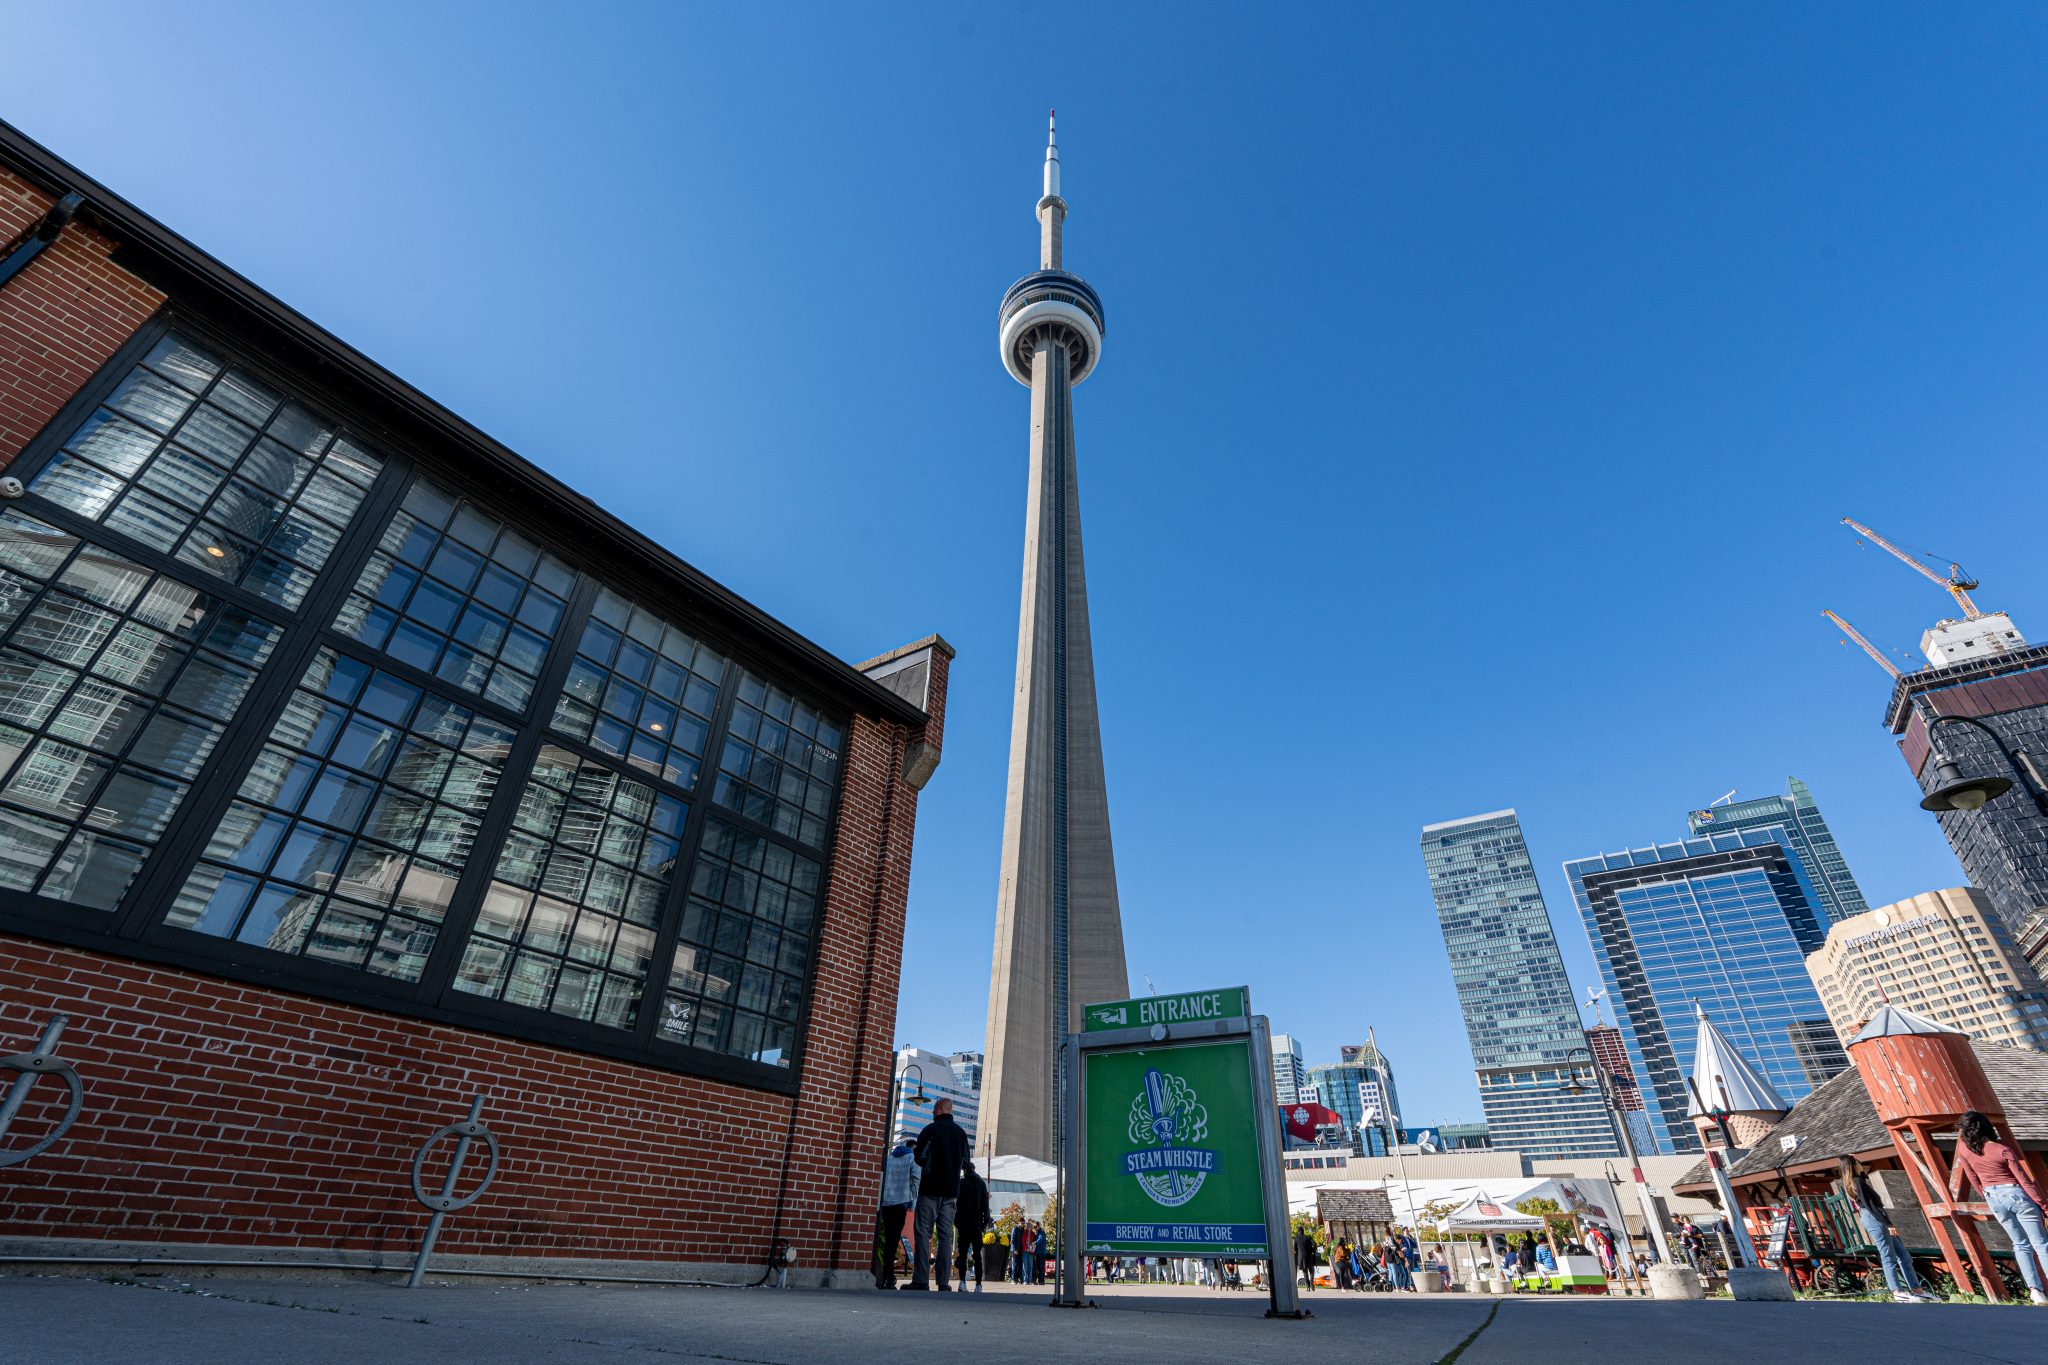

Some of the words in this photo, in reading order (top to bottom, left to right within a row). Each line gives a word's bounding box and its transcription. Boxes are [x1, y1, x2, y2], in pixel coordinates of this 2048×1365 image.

[1140, 994, 1221, 1024] ENTRANCE
[666, 1018, 689, 1030] SMILE
[1127, 1150, 1162, 1171] STEAM
[1163, 1150, 1213, 1169] WHISTLE
[1116, 1225, 1154, 1240] BREWERY
[1158, 1228, 1170, 1238] AND
[1172, 1226, 1202, 1240] RETAIL
[1204, 1226, 1233, 1241] STORE
